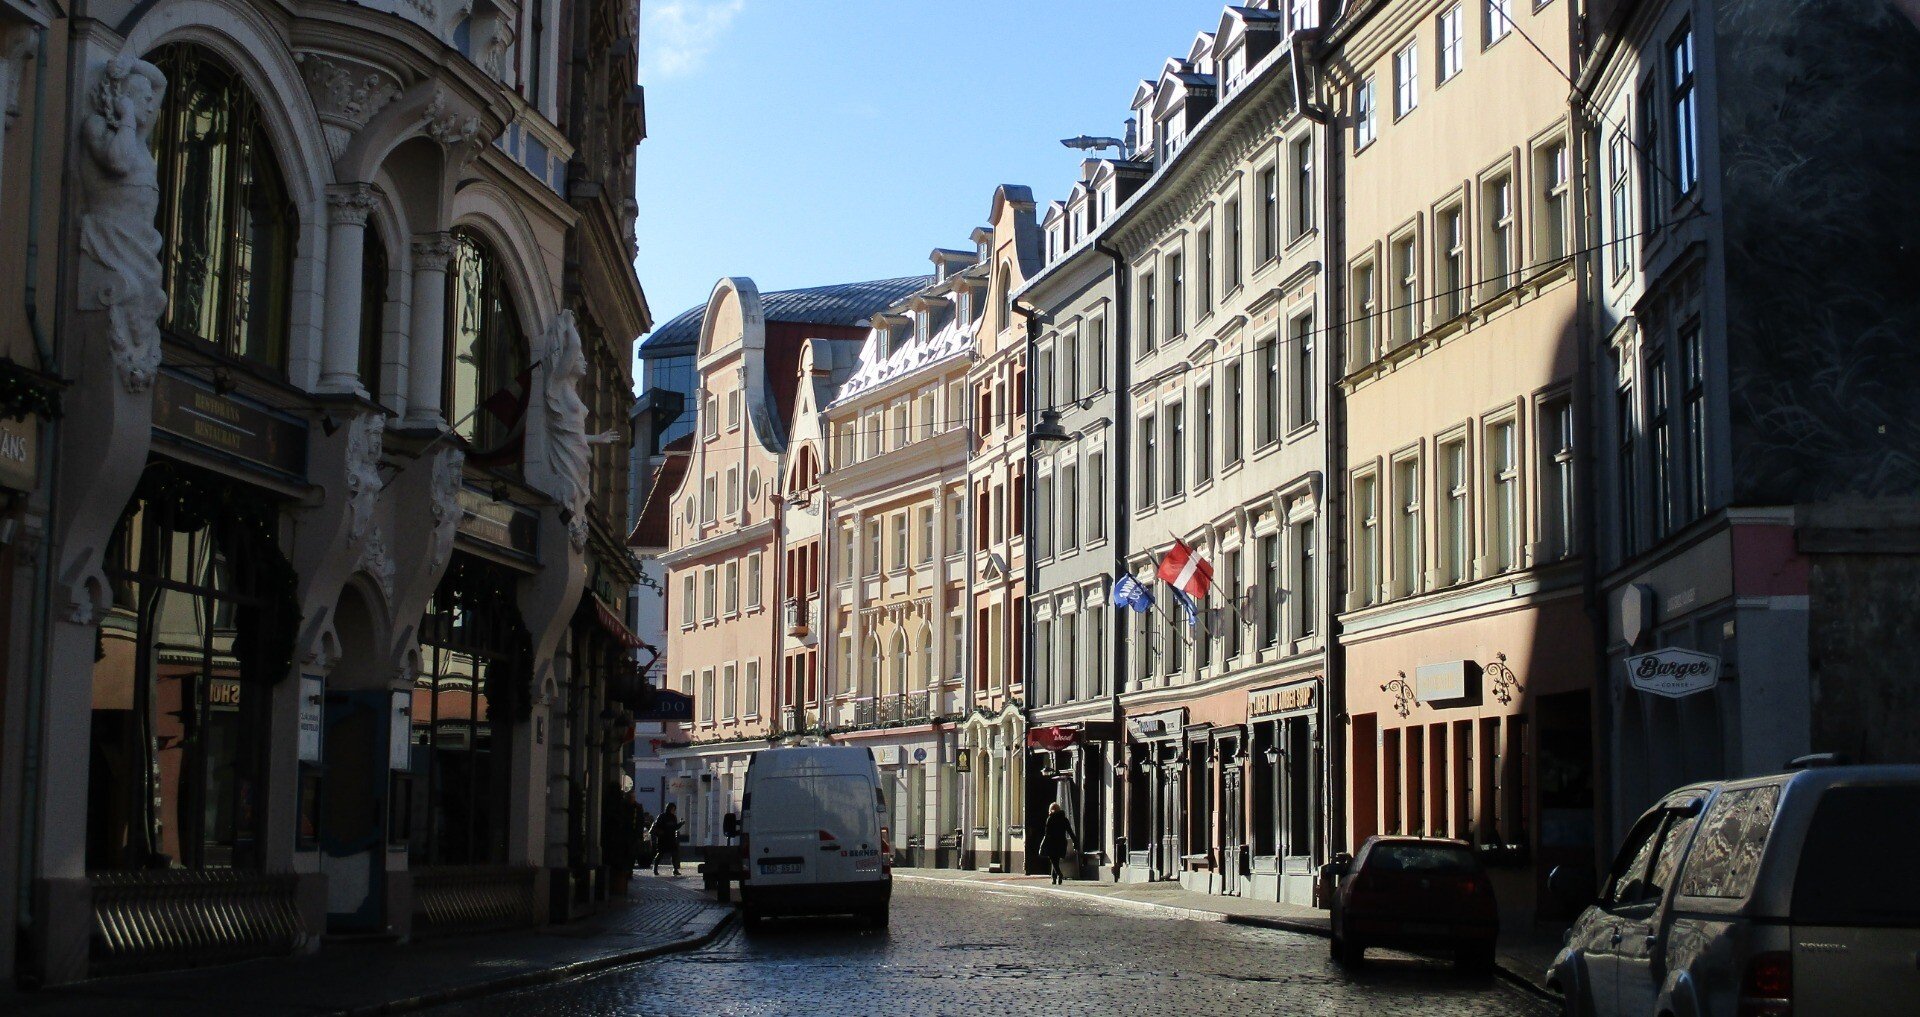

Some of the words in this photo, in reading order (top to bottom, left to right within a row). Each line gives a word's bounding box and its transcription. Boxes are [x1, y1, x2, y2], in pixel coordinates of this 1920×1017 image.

[194, 419, 240, 449] RESTAURANT
[1636, 655, 1711, 680] Burger
[1297, 686, 1311, 707] SHOP
[849, 849, 879, 857] BERNER
[1799, 942, 1848, 952] TOYOTA
